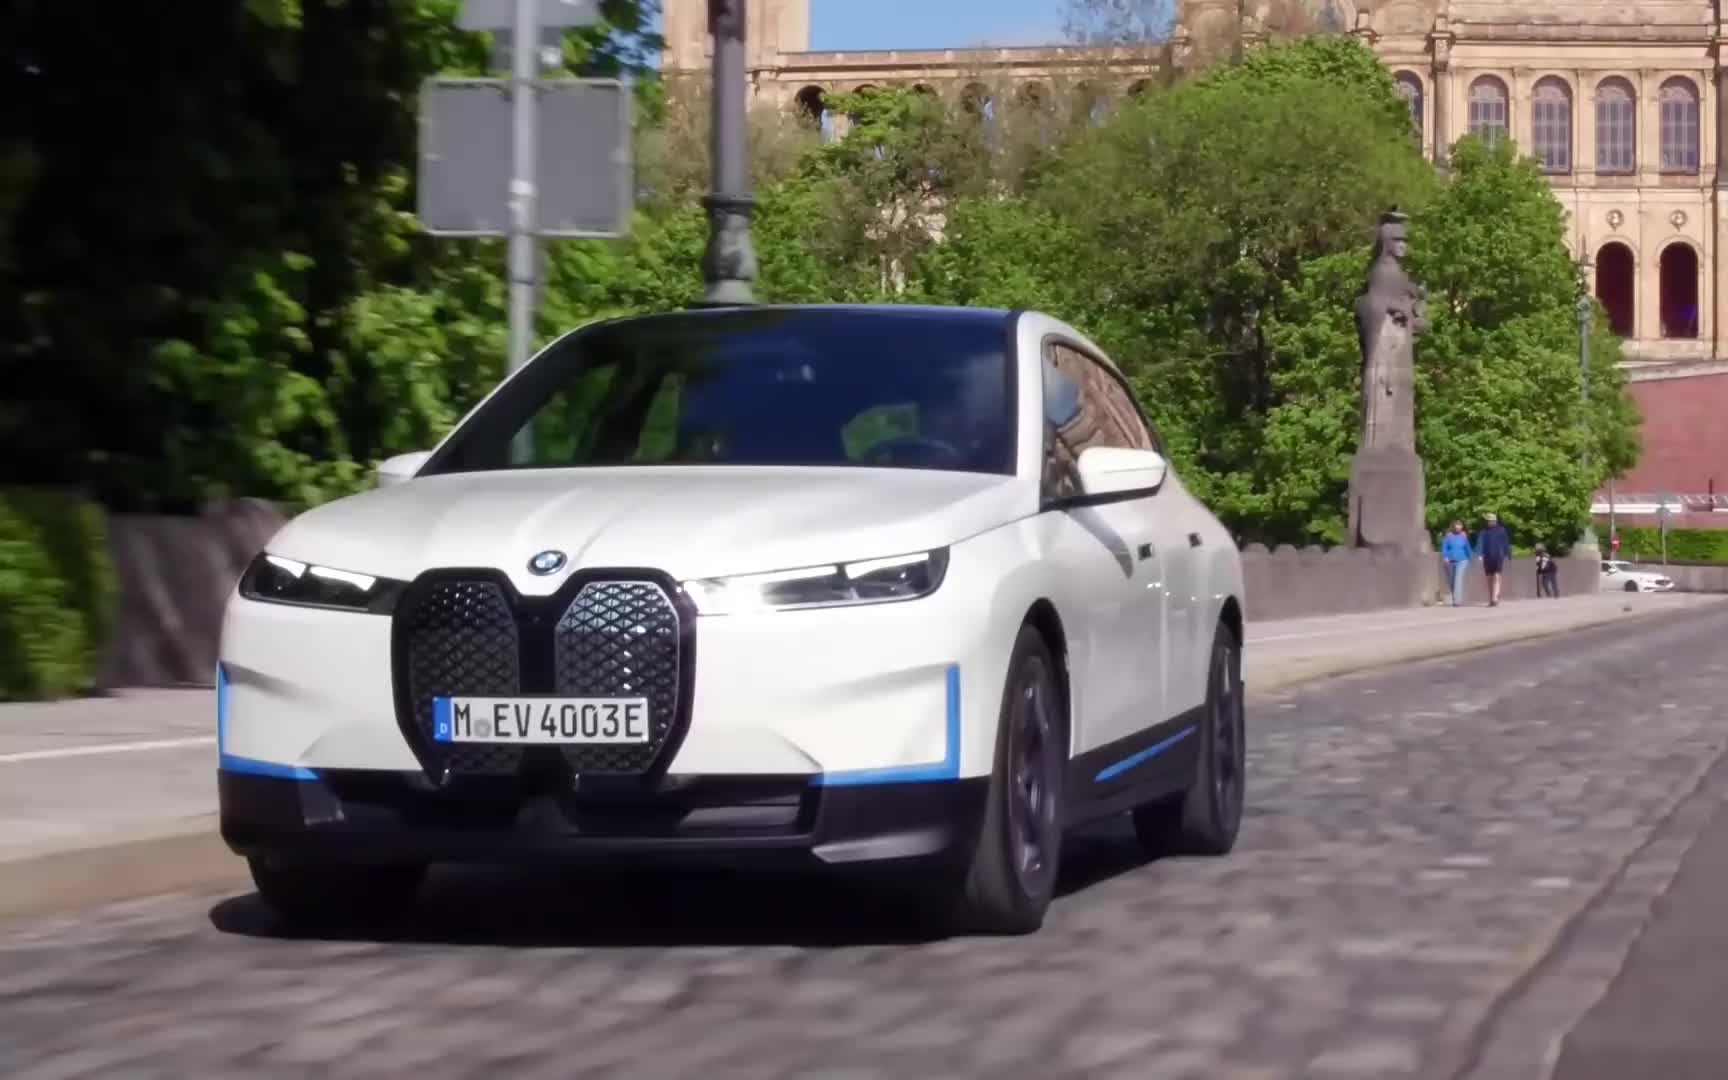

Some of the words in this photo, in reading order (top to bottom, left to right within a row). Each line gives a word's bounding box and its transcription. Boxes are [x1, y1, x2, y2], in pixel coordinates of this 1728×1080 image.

[453, 703, 471, 737] M
[493, 703, 531, 737] EV
[540, 703, 644, 738] 4003E
